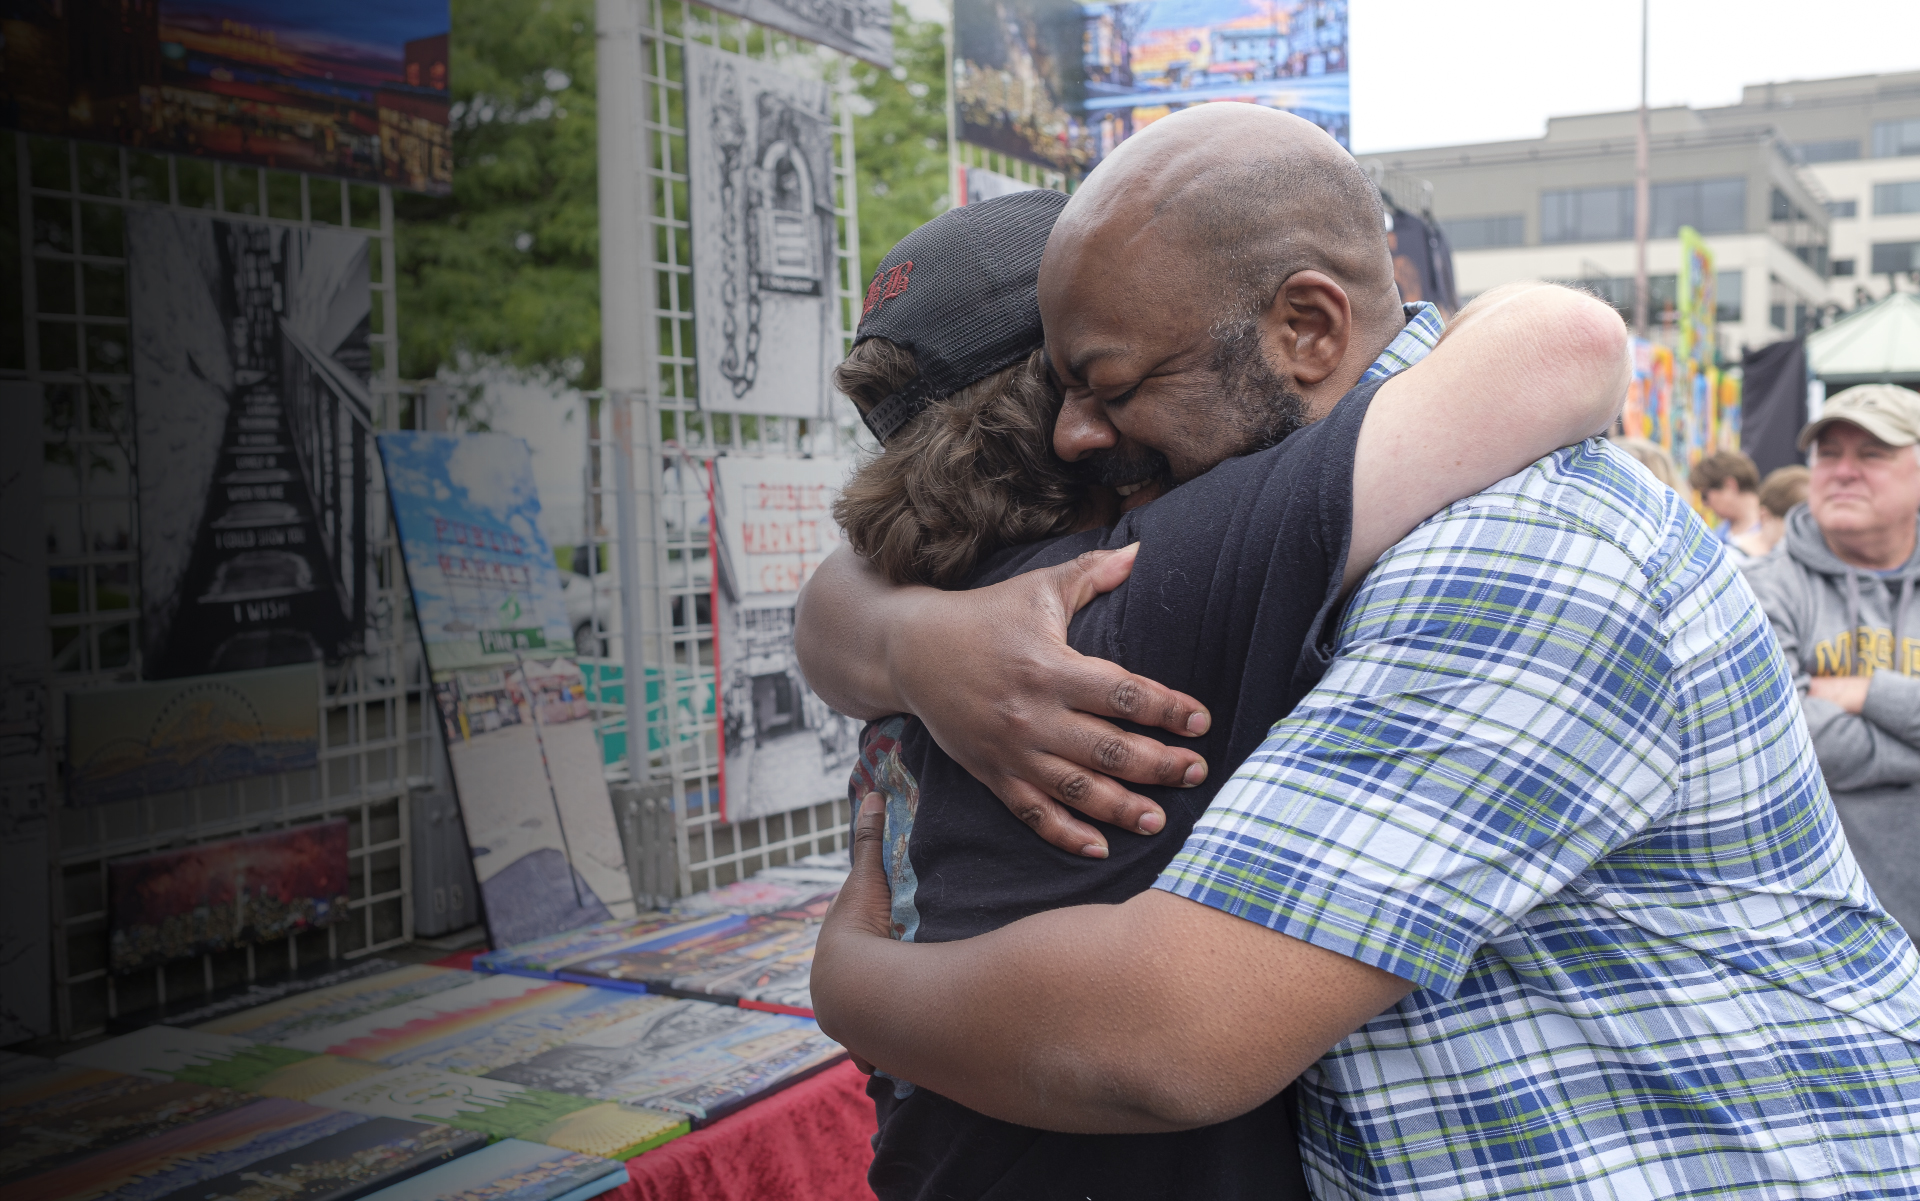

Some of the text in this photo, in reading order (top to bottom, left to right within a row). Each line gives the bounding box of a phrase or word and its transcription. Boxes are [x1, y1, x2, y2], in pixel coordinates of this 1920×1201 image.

[759, 482, 825, 511] PUBLIC
[223, 529, 256, 549] COULD
[257, 527, 286, 546] SHOW
[287, 526, 306, 544] YOU
[434, 518, 523, 555] PUBLIC
[233, 599, 291, 624] I WISH
